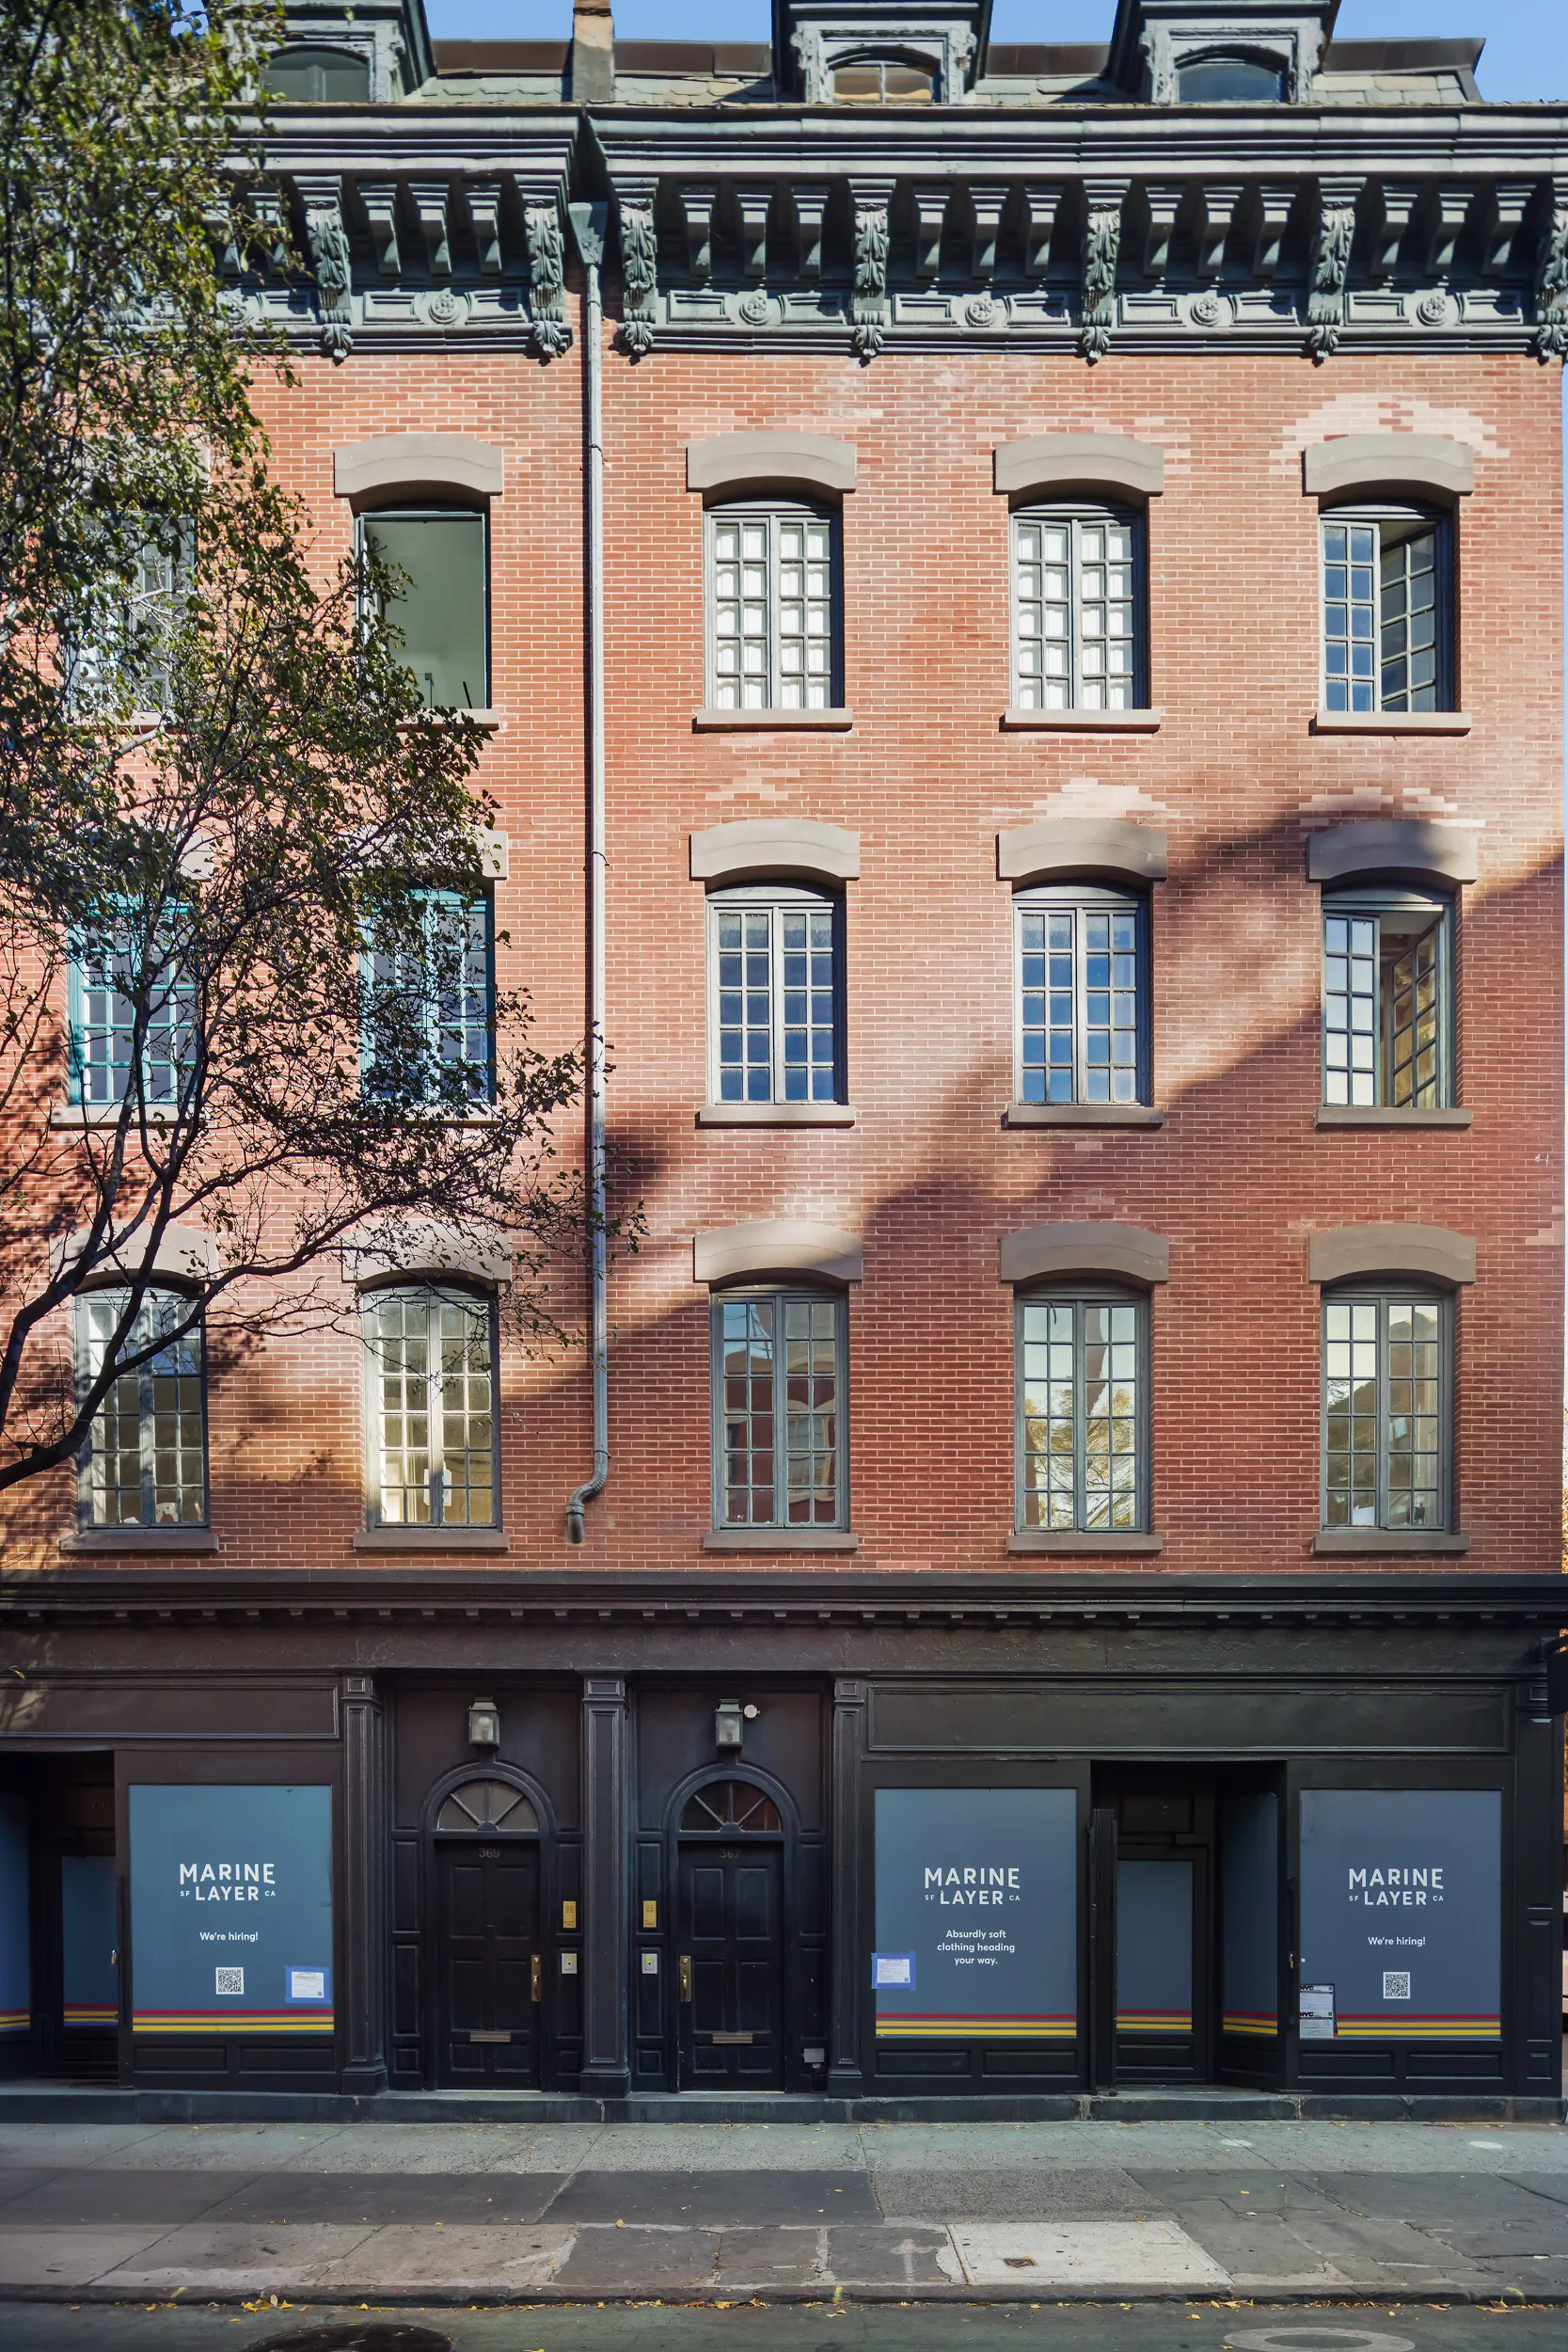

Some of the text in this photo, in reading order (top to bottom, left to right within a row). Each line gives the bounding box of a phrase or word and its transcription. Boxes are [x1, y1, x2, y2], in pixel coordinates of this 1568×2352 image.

[479, 1848, 499, 1858] 369
[720, 1849, 741, 1859] 367
[180, 1863, 276, 1885] MARINE
[925, 1867, 1021, 1889] MARINE
[1349, 1867, 1444, 1889] MARINE
[195, 1885, 260, 1901] LAYER
[940, 1890, 1004, 1905] LAYER
[1364, 1891, 1427, 1906] LAYER
[199, 1931, 259, 1943] We're hiring!
[945, 1930, 1006, 1940] Absurdly soft
[937, 1942, 1015, 1953] clothing heading
[1368, 1936, 1426, 1947] We're hiring!
[954, 1958, 998, 1966] your way.
